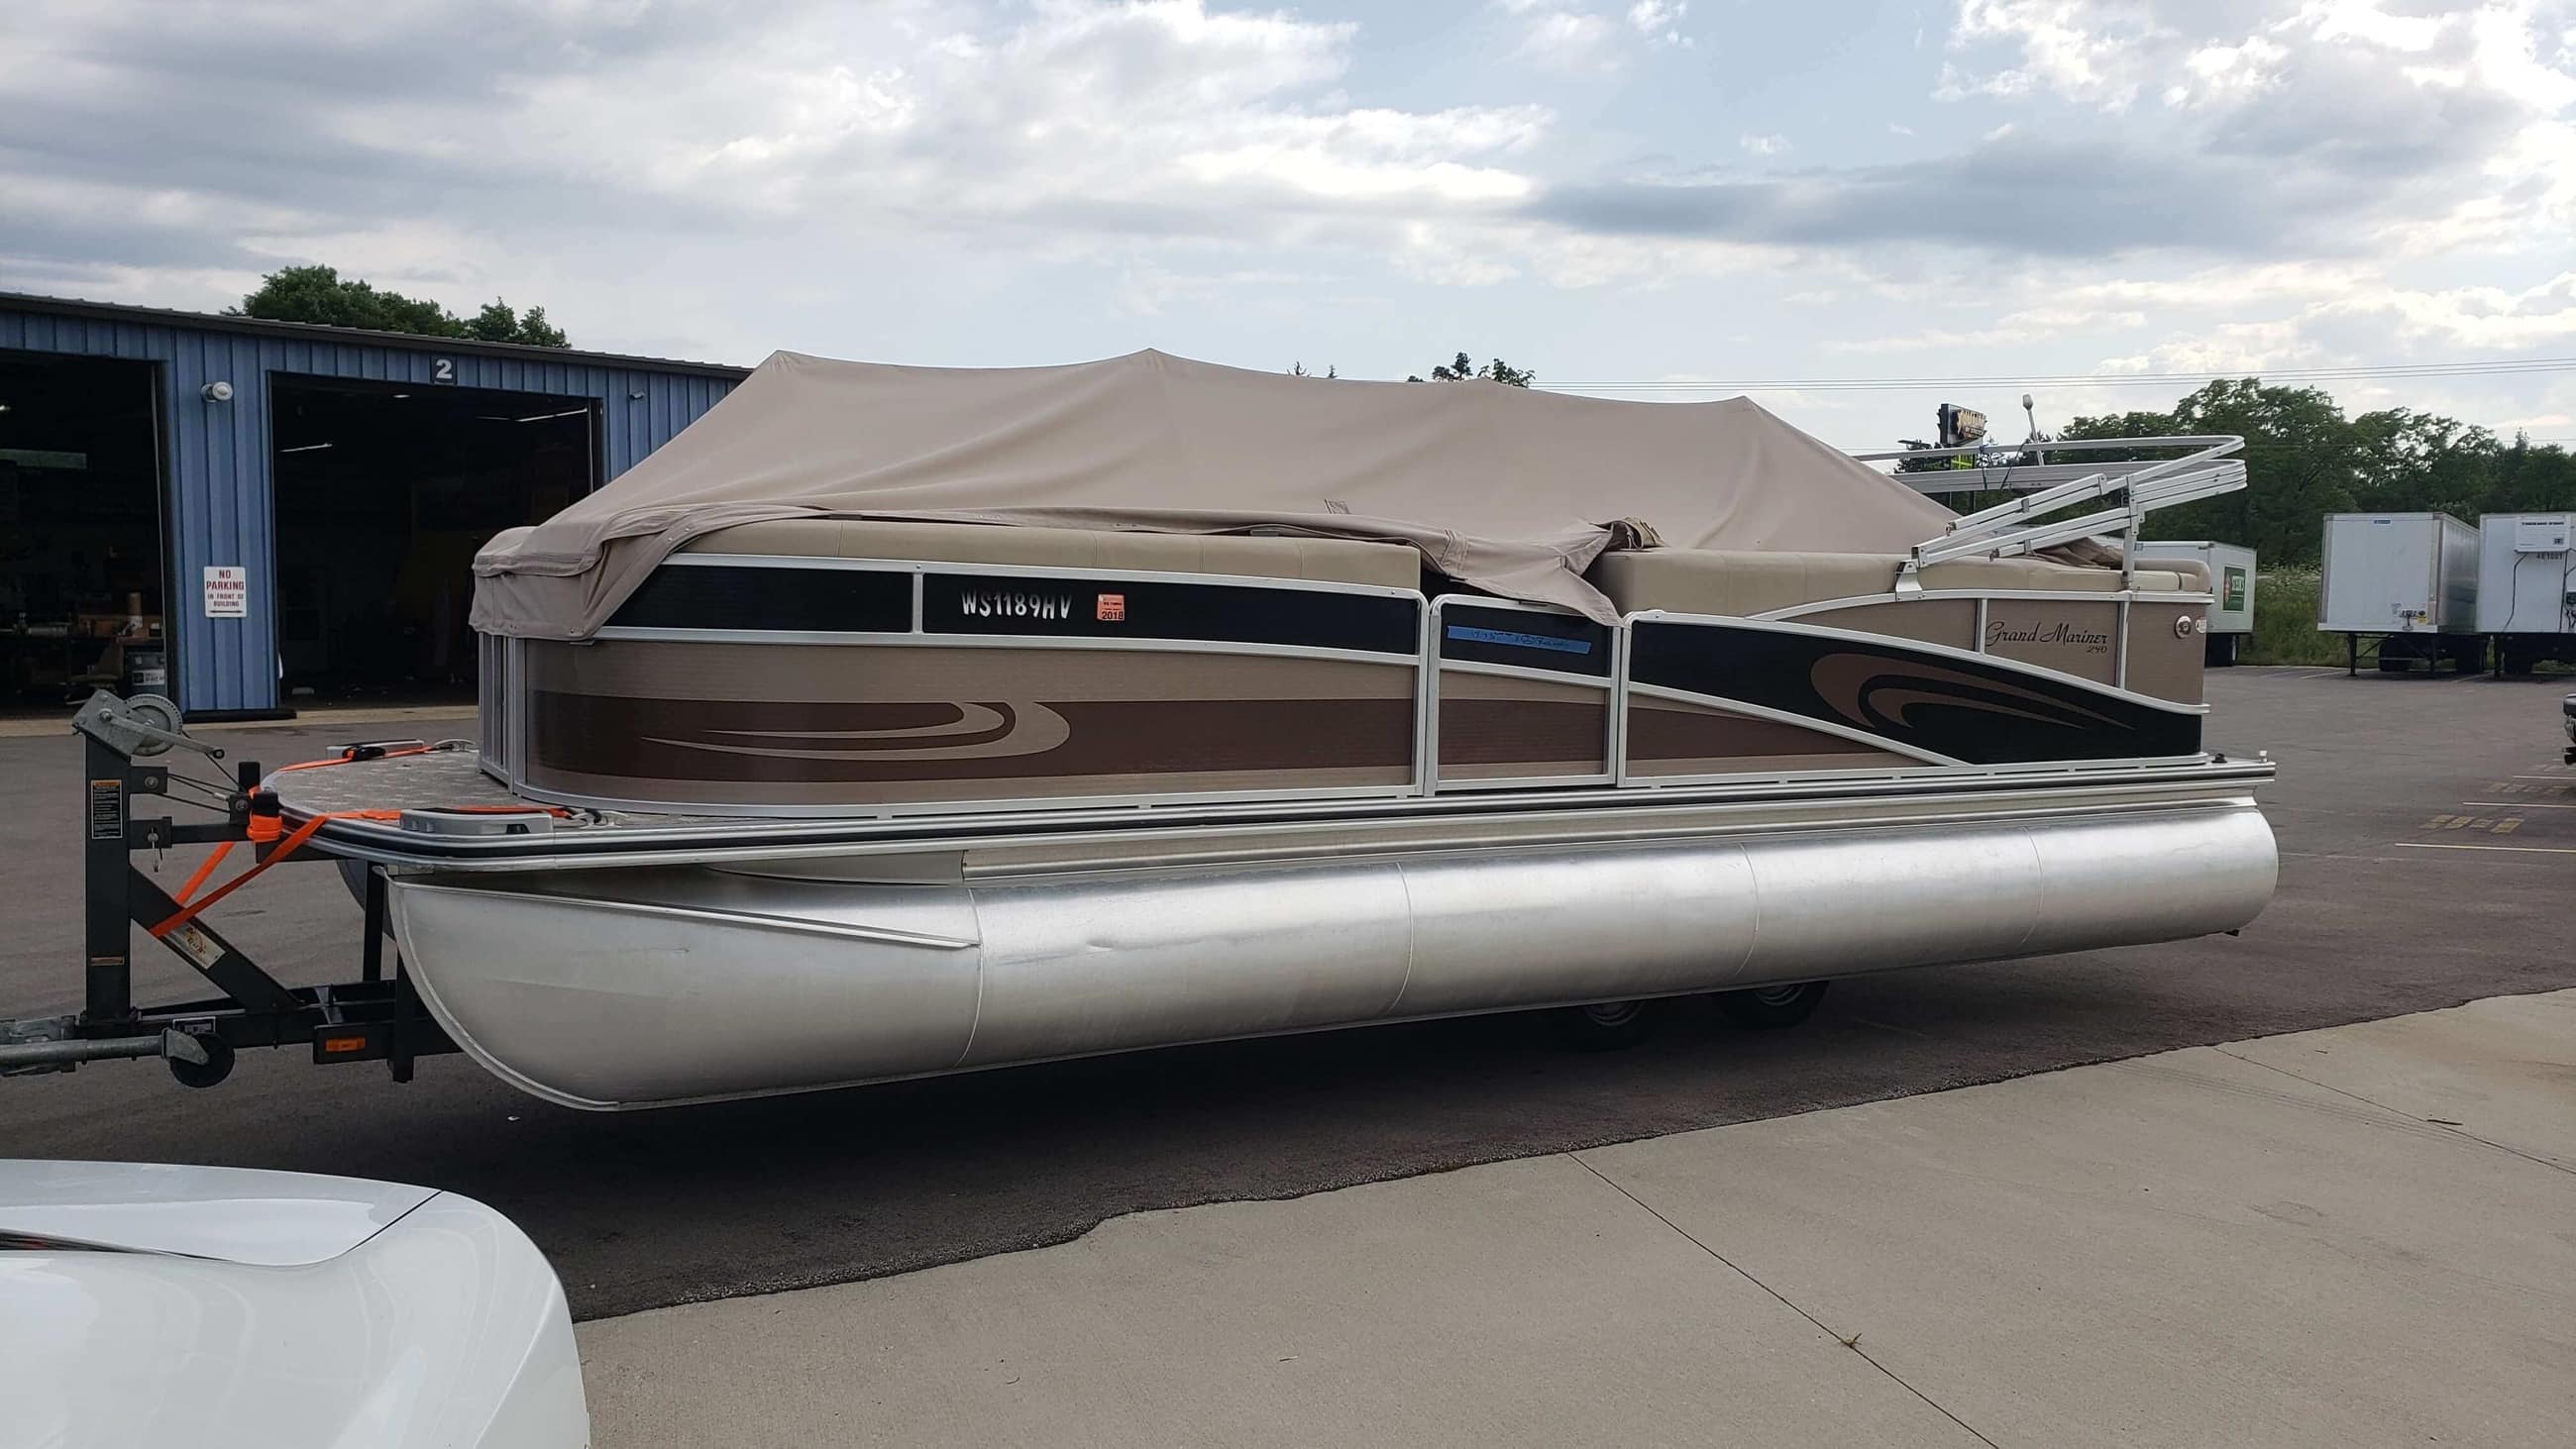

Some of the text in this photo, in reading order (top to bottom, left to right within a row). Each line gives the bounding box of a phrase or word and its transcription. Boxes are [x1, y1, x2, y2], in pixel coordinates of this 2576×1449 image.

[436, 359, 453, 379] 2
[218, 569, 232, 579] NO
[206, 580, 245, 590] PARKING
[1101, 610, 1124, 620] 2018
[1985, 621, 2108, 647] Grand Mariner
